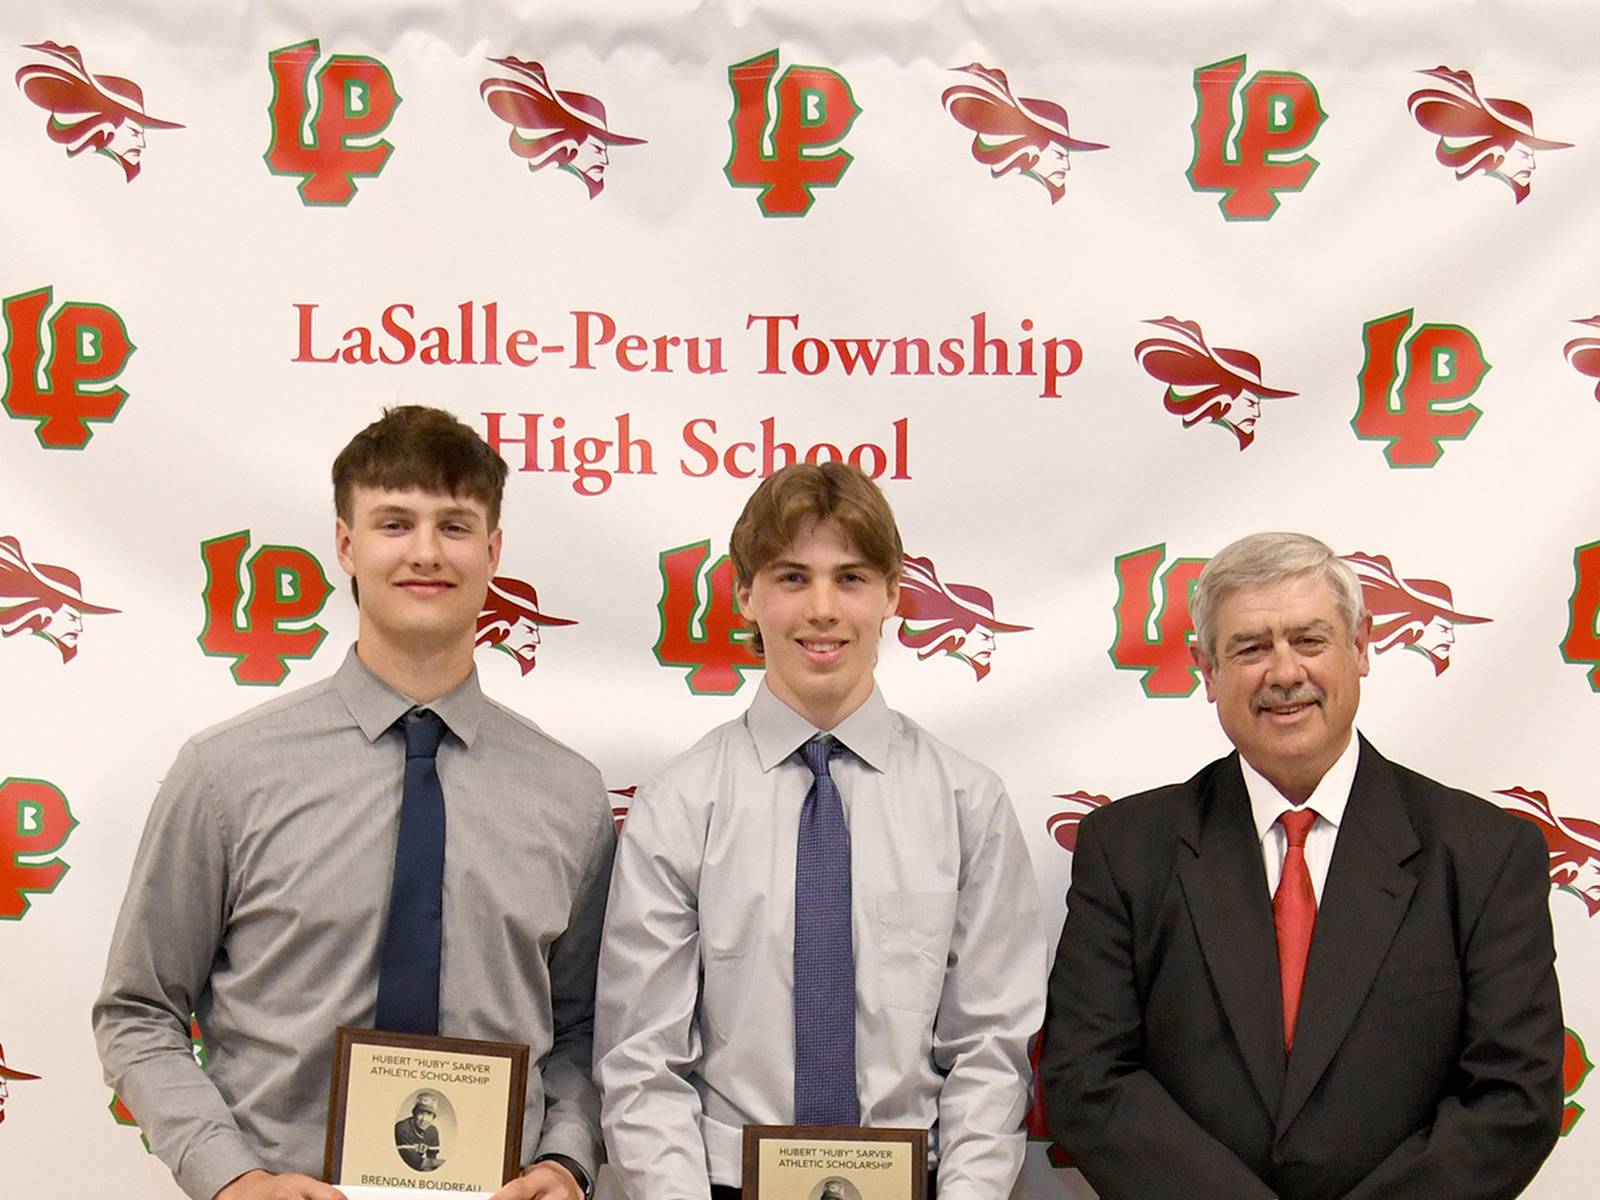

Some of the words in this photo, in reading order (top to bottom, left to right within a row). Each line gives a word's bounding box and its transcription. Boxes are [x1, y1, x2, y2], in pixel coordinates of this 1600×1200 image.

[291, 300, 727, 376] LaSalle-Peru
[746, 311, 1084, 398] Township
[480, 412, 657, 496] High
[371, 1054, 412, 1067] HUBERT
[414, 1058, 450, 1070] "HUBY"
[452, 1061, 491, 1074] SARVER
[370, 1066, 418, 1080] ATHLETIC
[420, 1070, 491, 1085] SCHOLARSHIP
[778, 1147, 817, 1157] HUBERT
[819, 1148, 854, 1158] "HUBY"
[856, 1149, 893, 1159] SARVER
[778, 1158, 824, 1169] ATHLETIC
[826, 1159, 894, 1170] SCHOLARSHIP
[360, 1174, 416, 1189] BRENDAN
